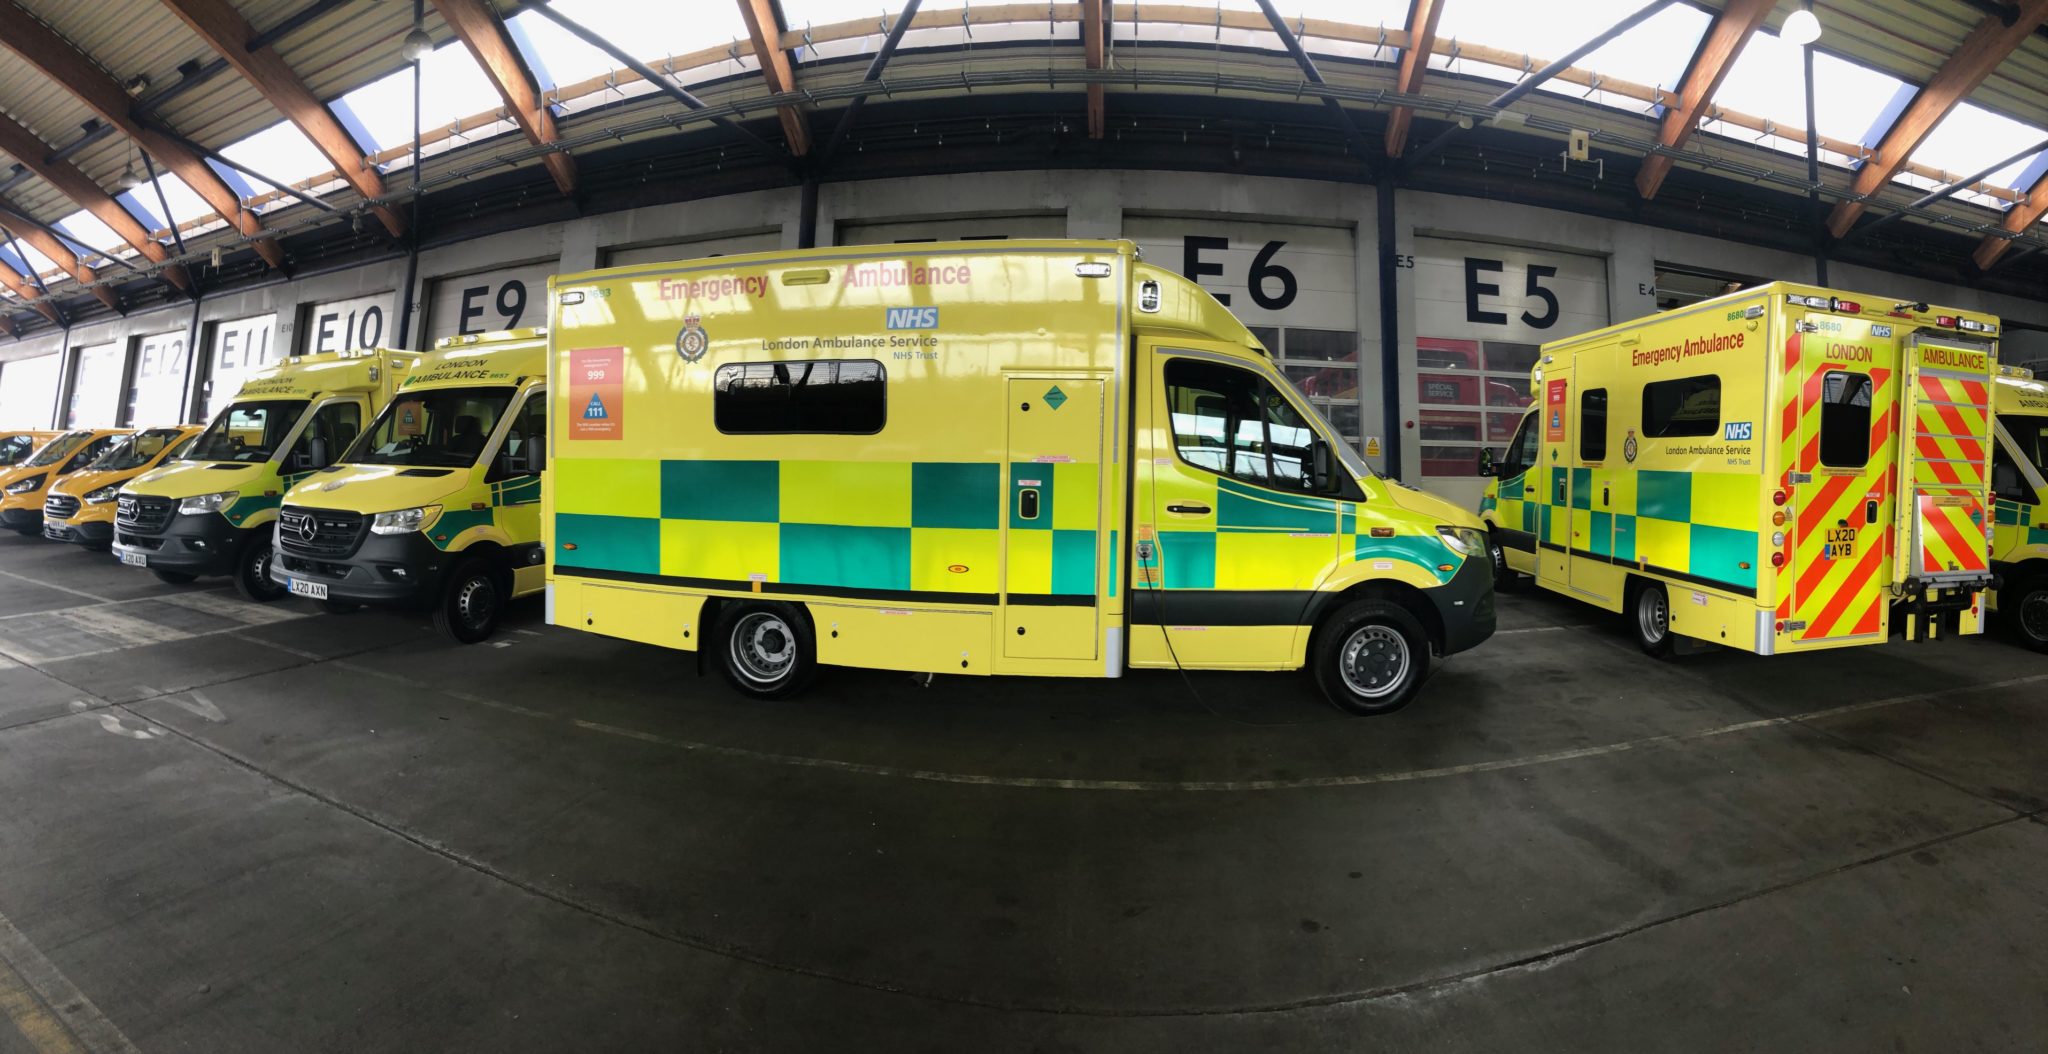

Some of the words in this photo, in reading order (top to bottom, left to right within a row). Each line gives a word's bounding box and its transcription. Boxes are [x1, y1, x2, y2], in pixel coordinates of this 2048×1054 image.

[1396, 254, 1414, 269] E5
[1183, 235, 1298, 311] E6
[658, 275, 769, 301] Emergency
[842, 261, 971, 288] Ambulance
[1464, 257, 1560, 329] E5
[1638, 283, 1655, 297] E4
[458, 279, 527, 335] E9
[887, 308, 938, 329] NHS
[1727, 310, 1744, 321] 8680
[281, 323, 293, 333] E10
[317, 305, 383, 353] E10
[1819, 320, 1841, 332] 8680
[1871, 325, 1891, 338] NHS
[220, 325, 269, 369] E11
[762, 338, 809, 350] London
[813, 336, 885, 349] Ambulance
[890, 335, 938, 347] Service
[1632, 344, 1682, 367] Emergency
[1683, 332, 1744, 357] Ambulance
[140, 339, 183, 378] E12
[893, 352, 912, 360] NHS
[915, 351, 938, 360] Trust
[1826, 342, 1873, 363] LONDON
[1923, 348, 1985, 370] AMBULANCE
[434, 359, 488, 371] LONDON
[412, 369, 490, 385] AMBULANCE
[587, 370, 605, 380] 999
[588, 407, 603, 417] 111
[1725, 423, 1751, 439] NHS
[1665, 446, 1688, 455] London
[1689, 445, 1724, 455] Ambulance
[1726, 445, 1751, 455] Service
[1727, 458, 1737, 466] NHS
[1828, 528, 1855, 542] LX20
[1831, 543, 1852, 557] AYB
[291, 580, 309, 594] LX20
[311, 584, 326, 597] AXN
